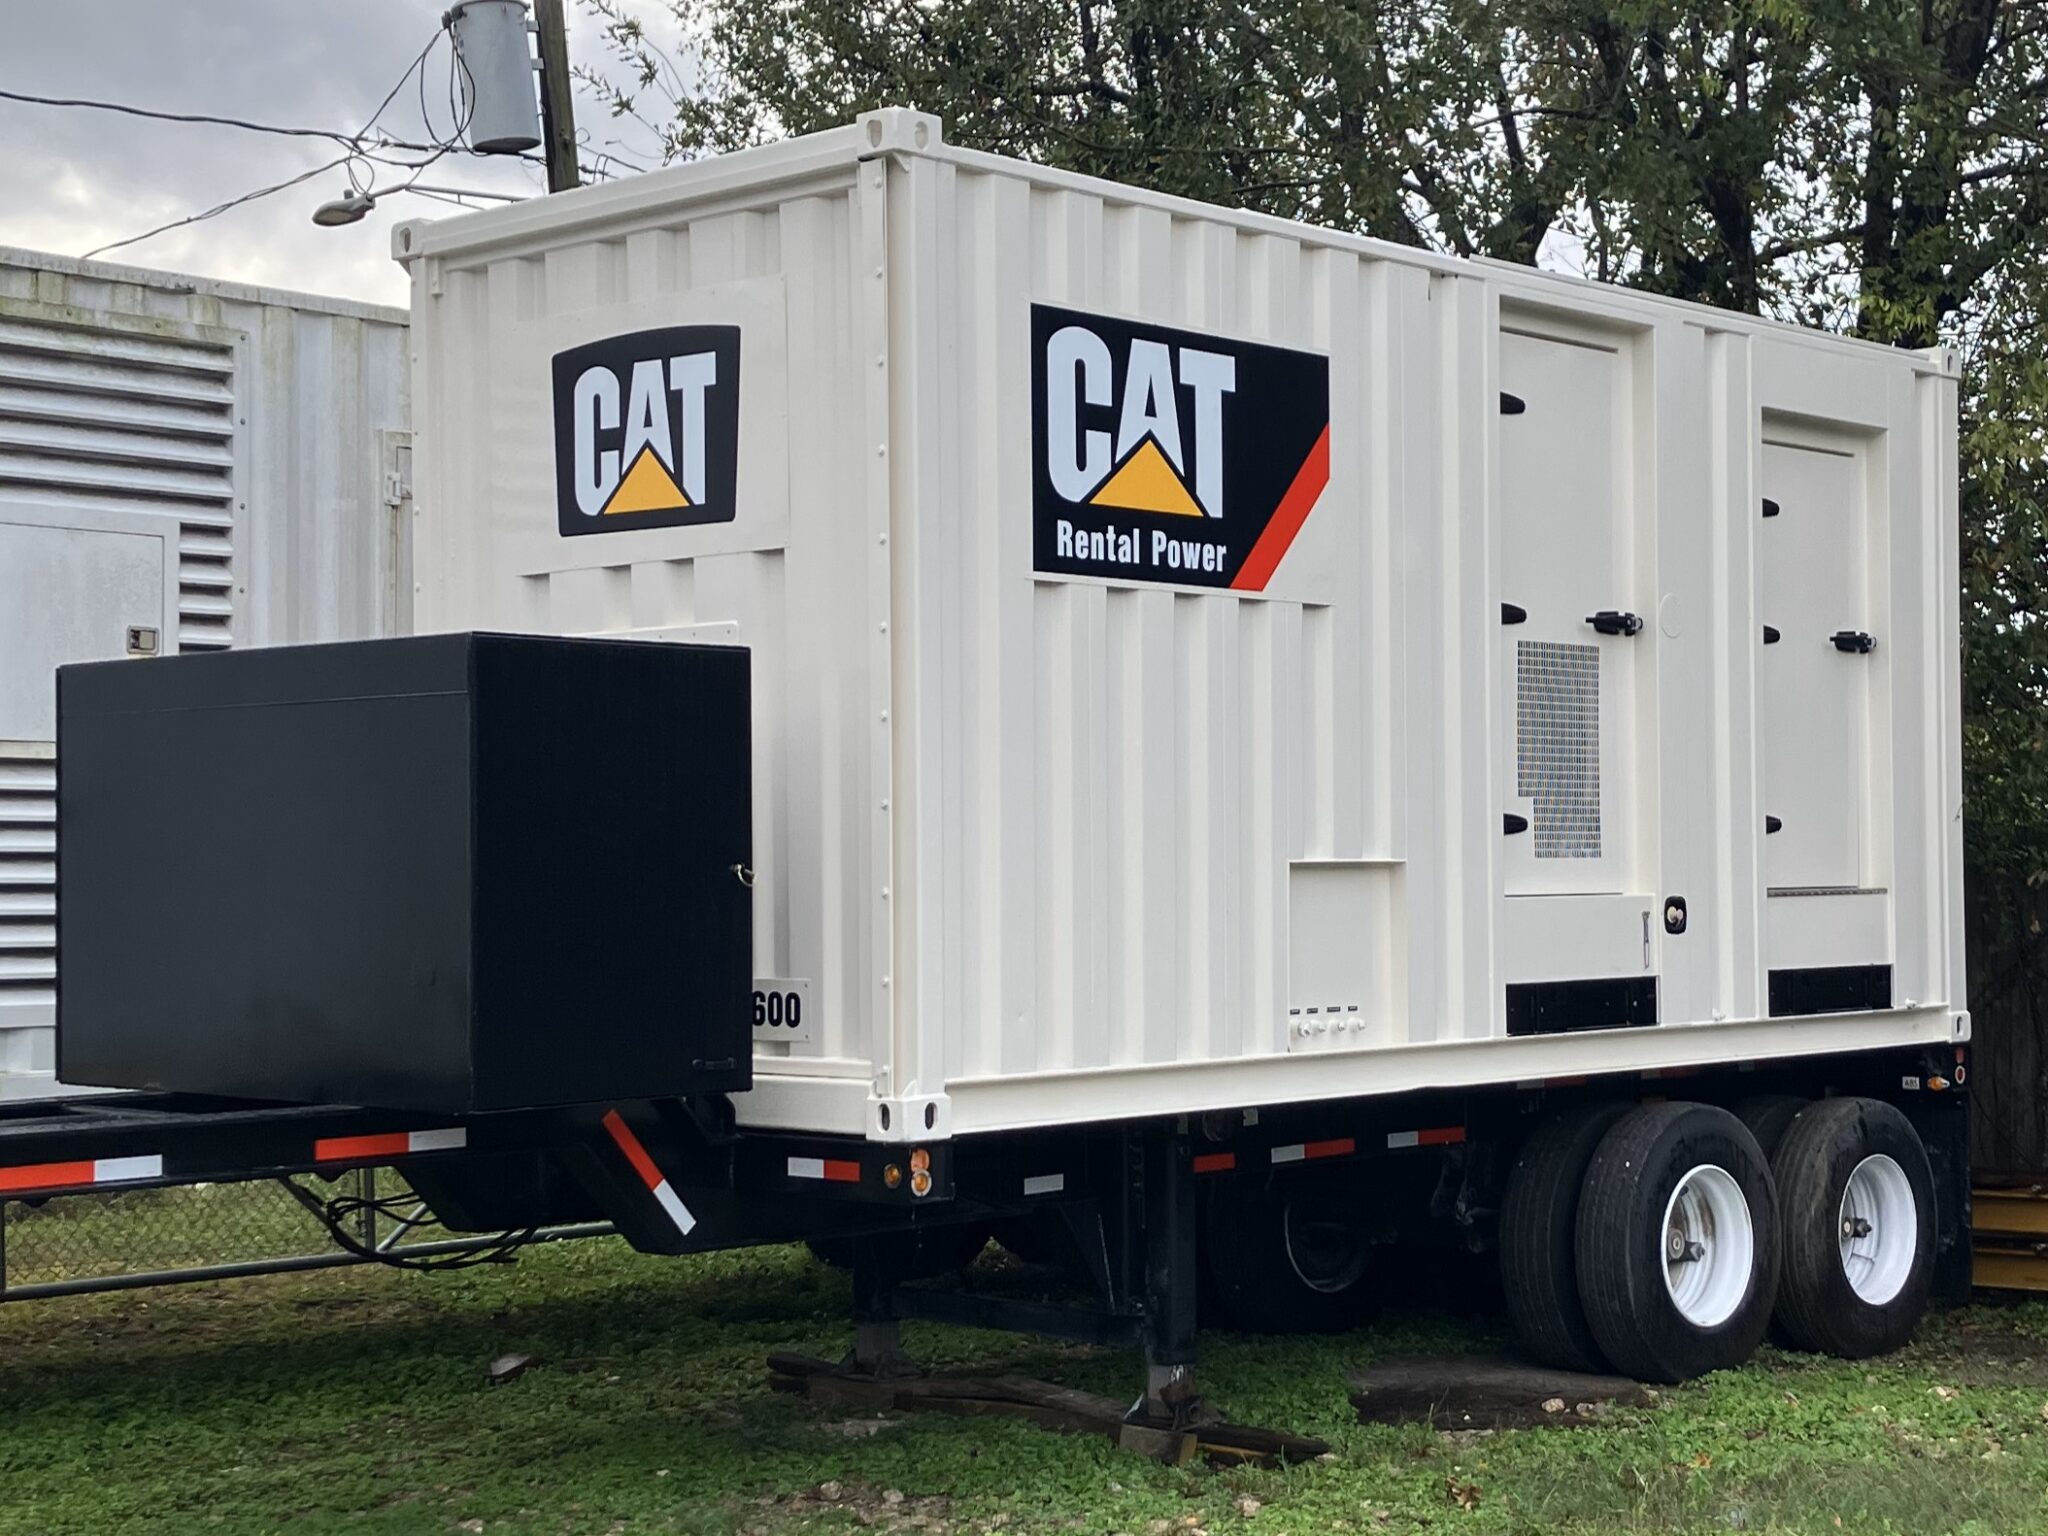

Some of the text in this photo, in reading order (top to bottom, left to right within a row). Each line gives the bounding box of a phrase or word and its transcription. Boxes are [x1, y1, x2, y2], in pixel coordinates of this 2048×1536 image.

[574, 351, 717, 517] CAT
[1047, 325, 1236, 519] CAT
[1056, 519, 1227, 572] Rental Power
[752, 991, 801, 1028] 600
